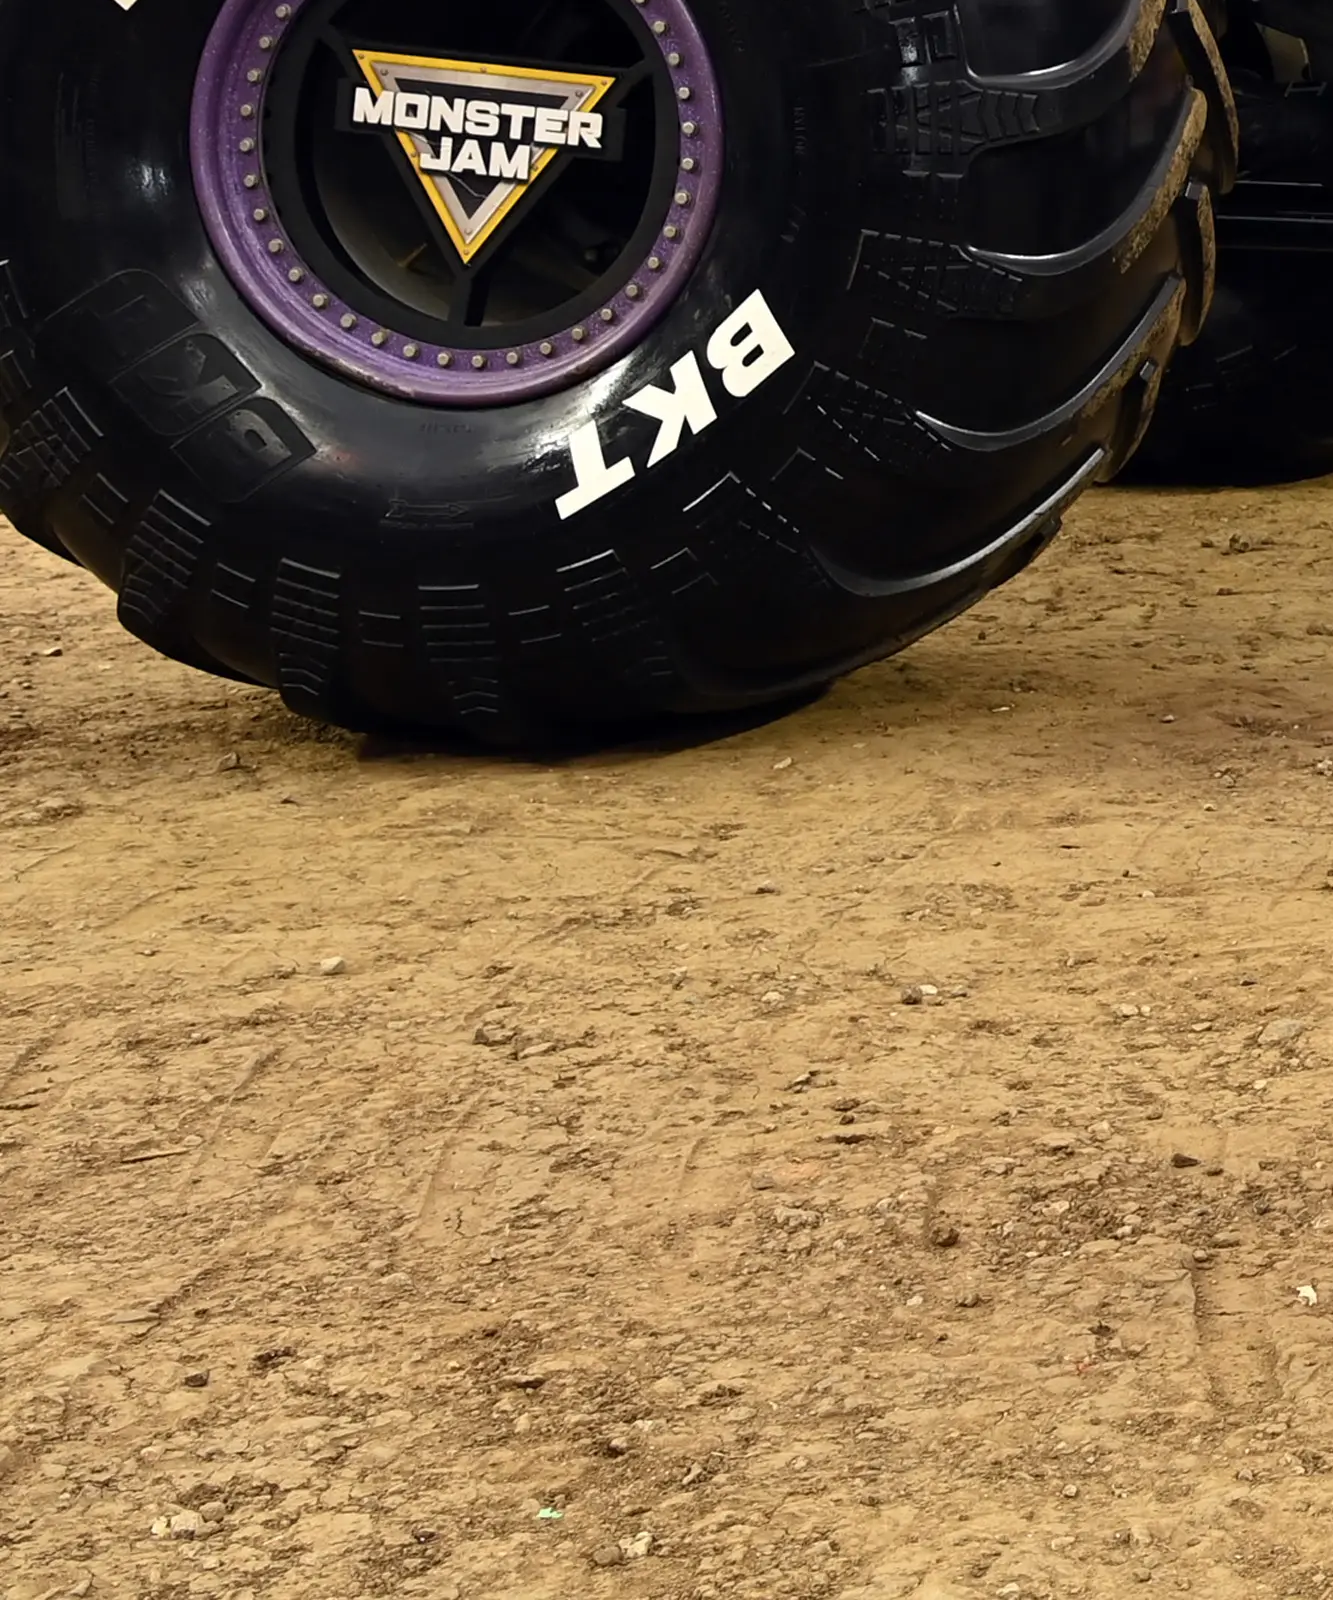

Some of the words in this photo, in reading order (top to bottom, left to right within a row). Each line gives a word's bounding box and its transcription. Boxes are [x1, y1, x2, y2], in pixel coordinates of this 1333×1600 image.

[353, 87, 603, 150] MONSTER
[418, 135, 531, 181] JAM
[554, 288, 796, 520] BKT
